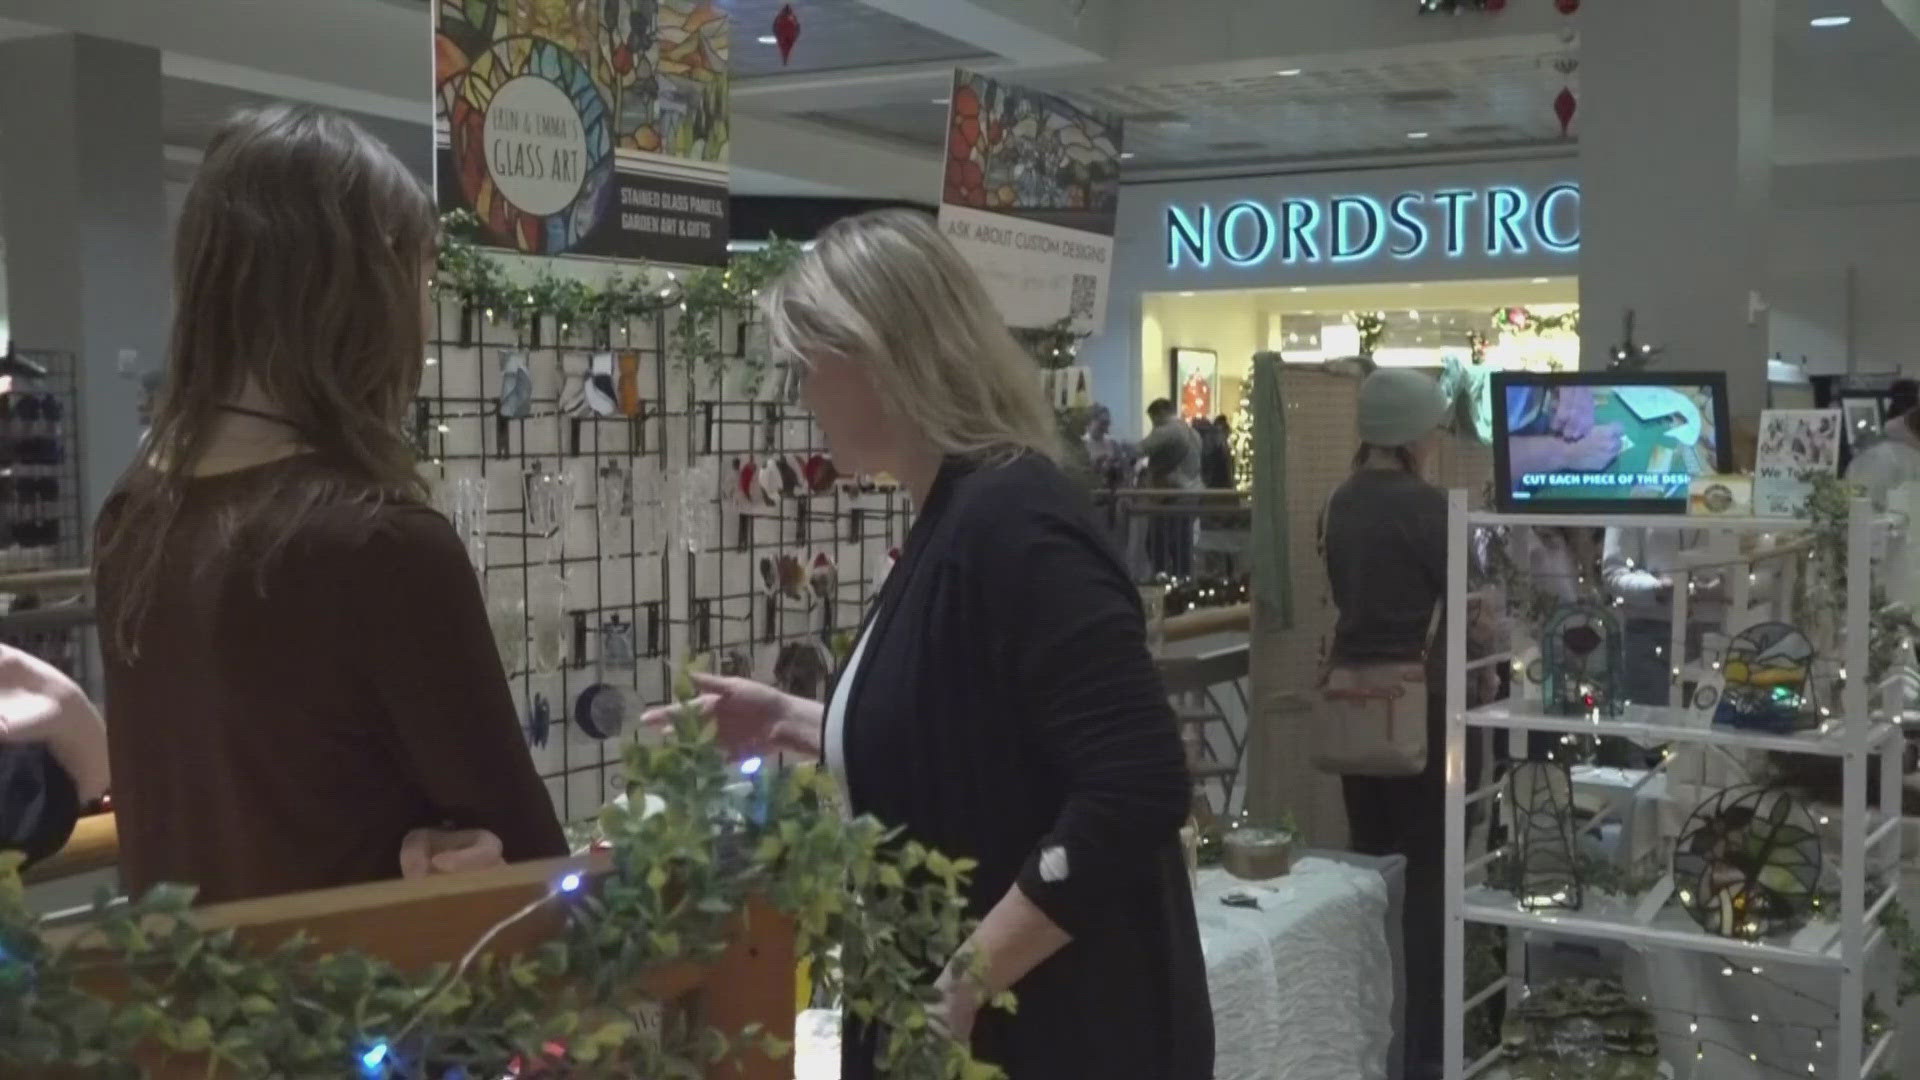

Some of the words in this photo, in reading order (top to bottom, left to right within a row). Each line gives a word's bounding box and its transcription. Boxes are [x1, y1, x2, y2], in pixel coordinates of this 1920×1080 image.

[493, 106, 519, 131] ERIN
[523, 111, 532, 135] &
[536, 111, 578, 140] EMMA'S
[494, 138, 544, 178] GLASS
[552, 148, 578, 183] ART
[621, 186, 660, 208] STAINED
[661, 191, 689, 212] GLASS
[622, 212, 659, 233] GARDEN
[660, 216, 678, 235] ART
[678, 219, 687, 237] &
[687, 220, 711, 239] GIFTS
[948, 220, 971, 240] ASK
[974, 222, 1013, 247] ABOUT
[1014, 231, 1060, 254] CUSTOM
[1062, 240, 1107, 264] DESIGNS
[1522, 473, 1546, 486] CUT
[1548, 473, 1581, 486] EACH
[1583, 473, 1616, 486] PIECE
[1617, 473, 1635, 486] OF
[1636, 473, 1659, 486] THE
[1662, 473, 1691, 486] DESI
